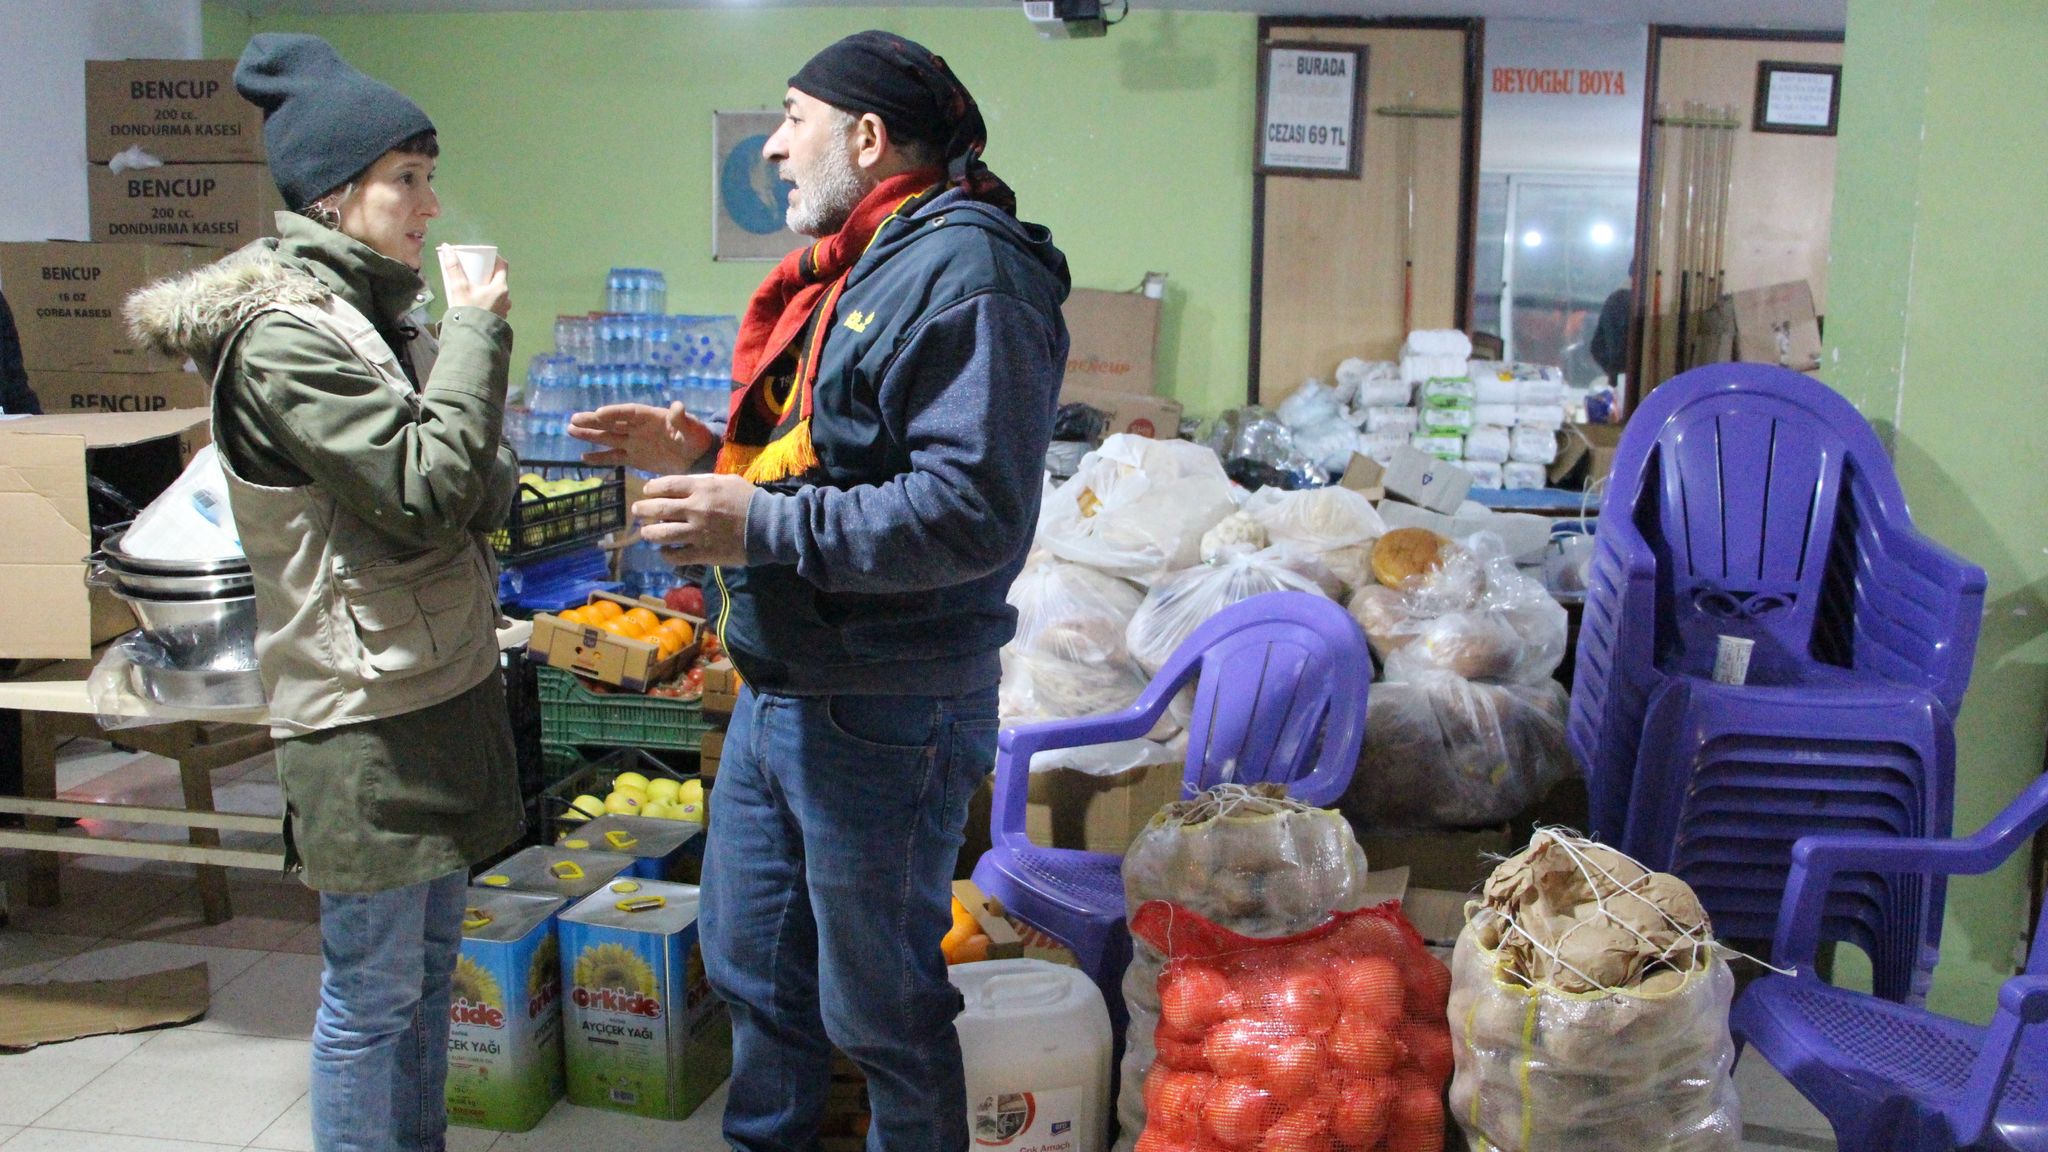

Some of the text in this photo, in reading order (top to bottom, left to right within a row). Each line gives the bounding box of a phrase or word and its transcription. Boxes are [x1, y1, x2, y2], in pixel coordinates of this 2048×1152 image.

[1296, 56, 1346, 76] BURADA
[1578, 69, 1625, 95] BOYA
[130, 80, 219, 99] BENCUP
[155, 109, 177, 120] 200
[110, 123, 241, 136] DONDURMA KASESİ
[1268, 123, 1346, 146] CEZASI 69 TL
[128, 179, 216, 198] BENCUP
[152, 208, 174, 218] 200
[109, 221, 239, 235] DONDURMA KASESİ
[42, 267, 101, 280] BENCUP
[73, 293, 86, 302] OZ
[37, 308, 71, 319] ÇORBA
[627, 1026, 653, 1041] YAĞI
[471, 1040, 500, 1055] YAĞI
